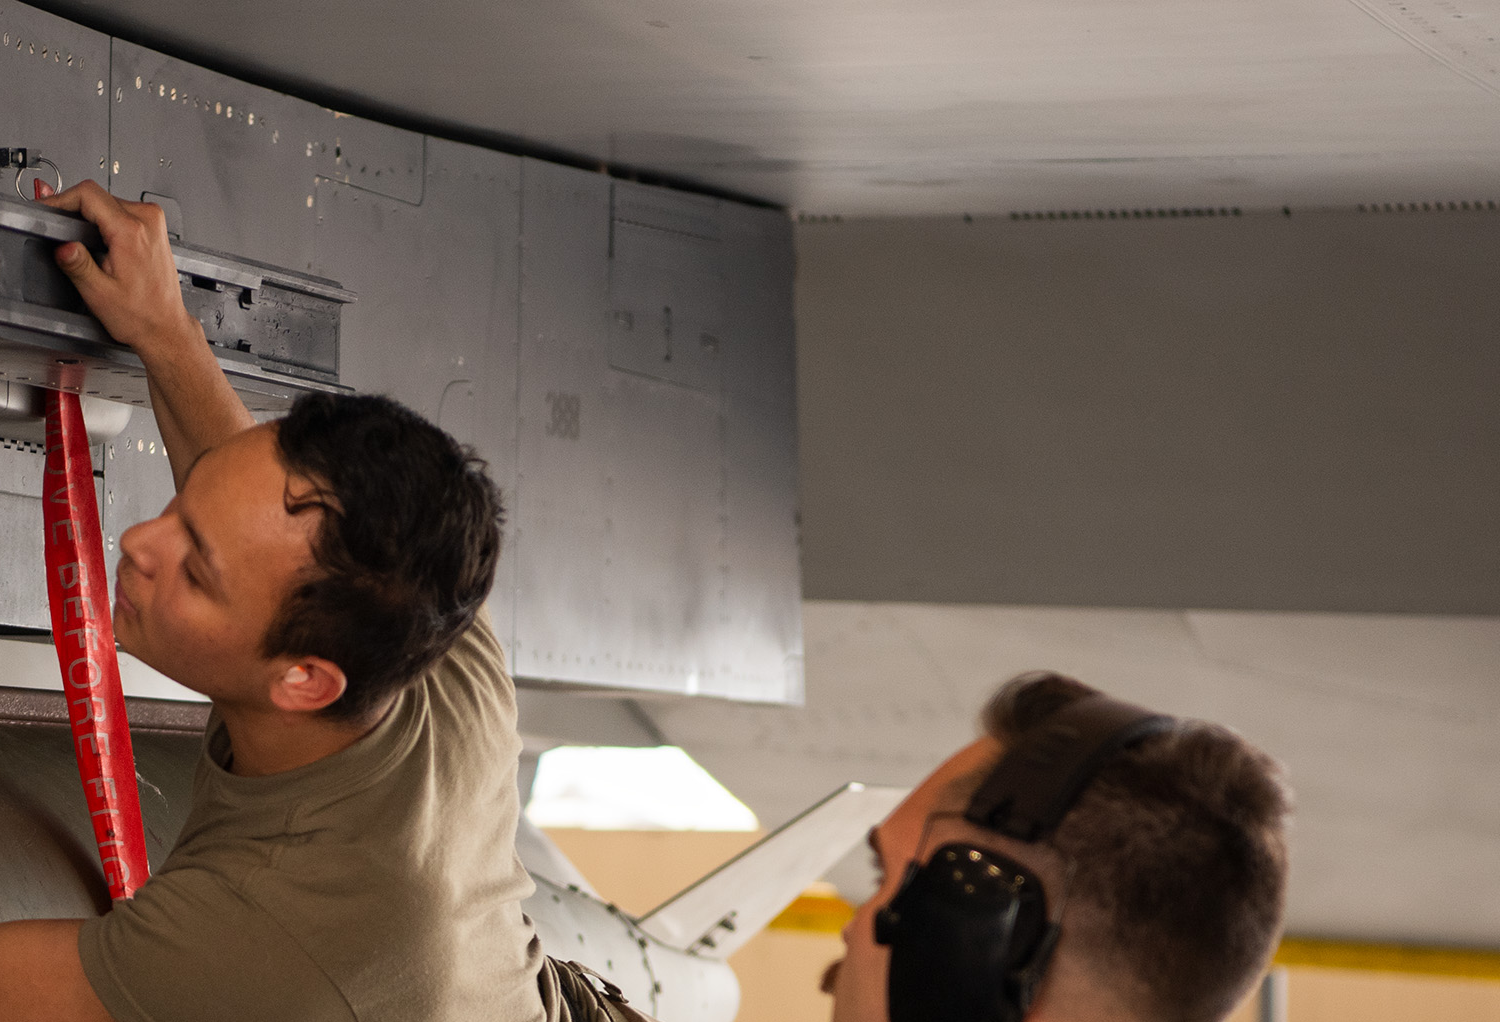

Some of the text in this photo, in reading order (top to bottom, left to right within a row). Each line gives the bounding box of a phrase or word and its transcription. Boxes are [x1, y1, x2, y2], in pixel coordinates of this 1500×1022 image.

[46, 400, 133, 899] MOVE BEFORE FLIG
